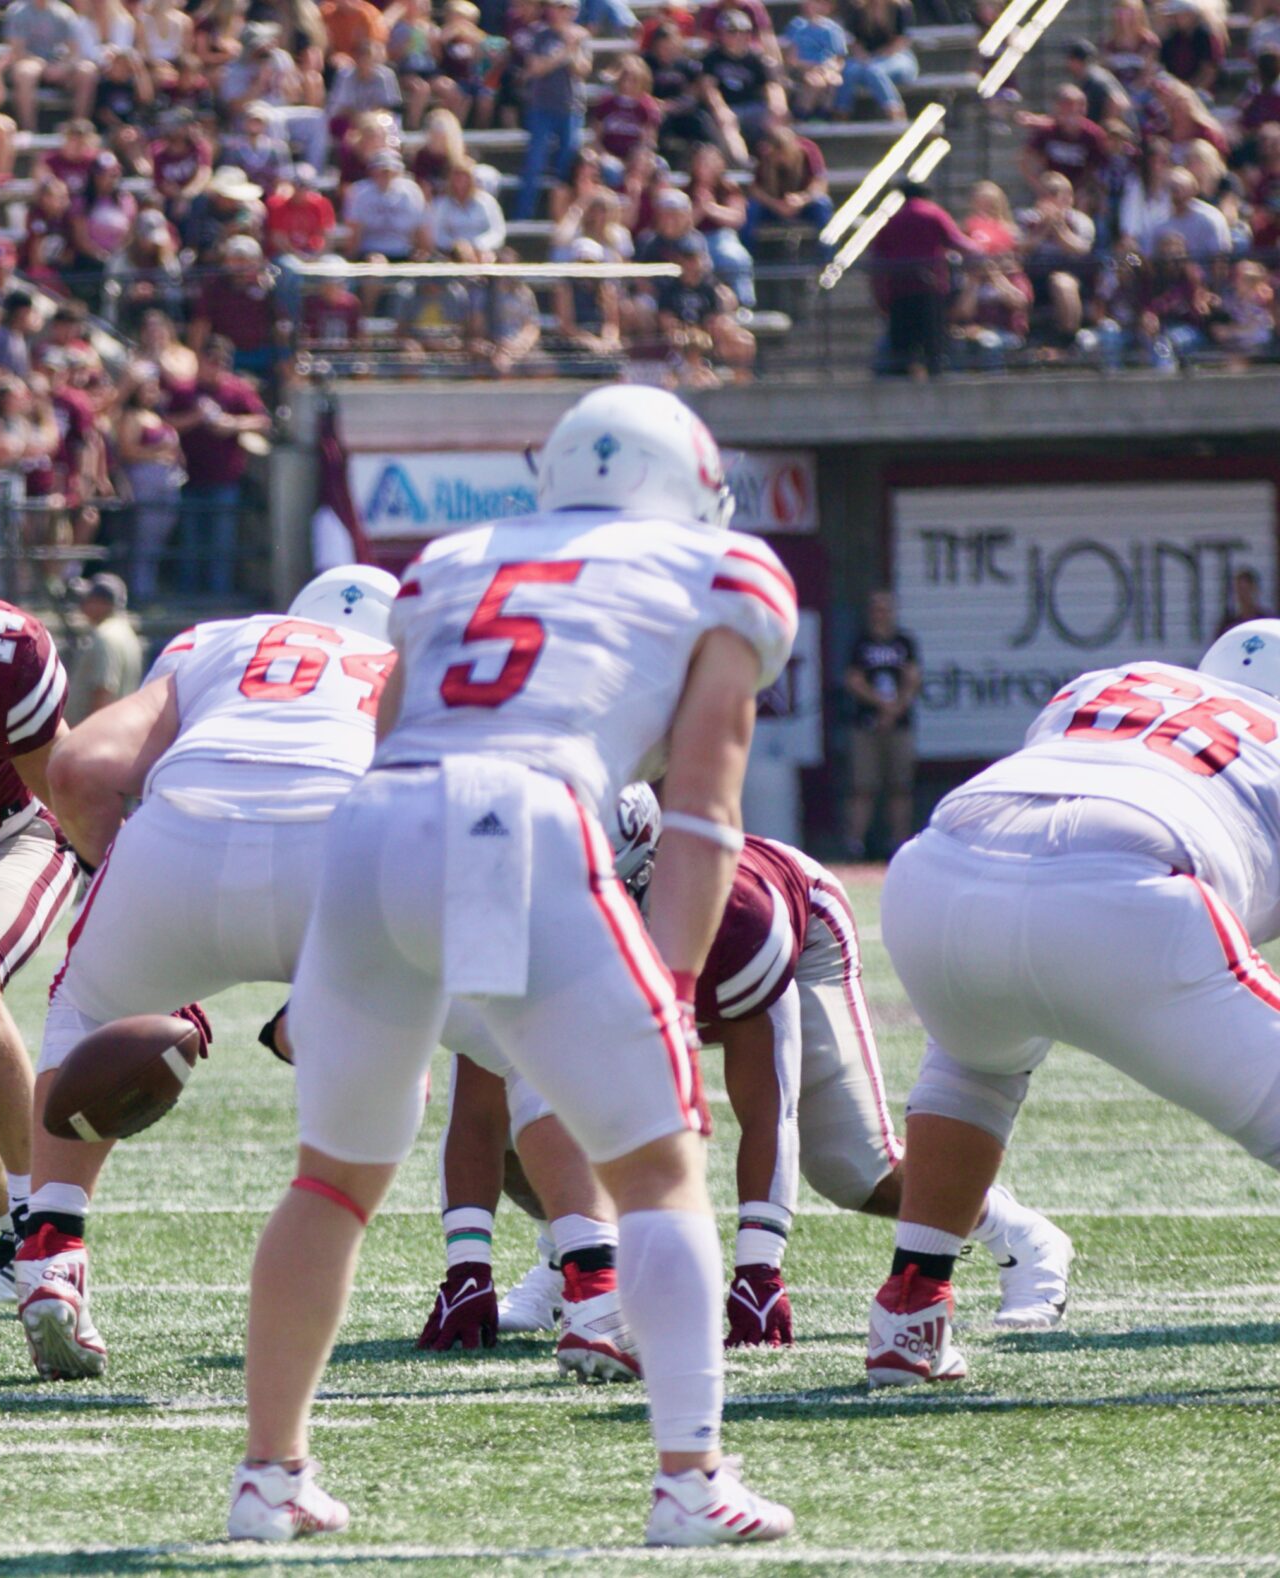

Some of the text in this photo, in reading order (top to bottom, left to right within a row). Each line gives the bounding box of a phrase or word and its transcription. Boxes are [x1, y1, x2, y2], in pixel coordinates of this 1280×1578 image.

[922, 526, 1014, 584] THE
[1008, 535, 1250, 648] JOINT
[238, 619, 400, 719] 64
[440, 559, 588, 708] 5
[1064, 672, 1279, 778] 66
